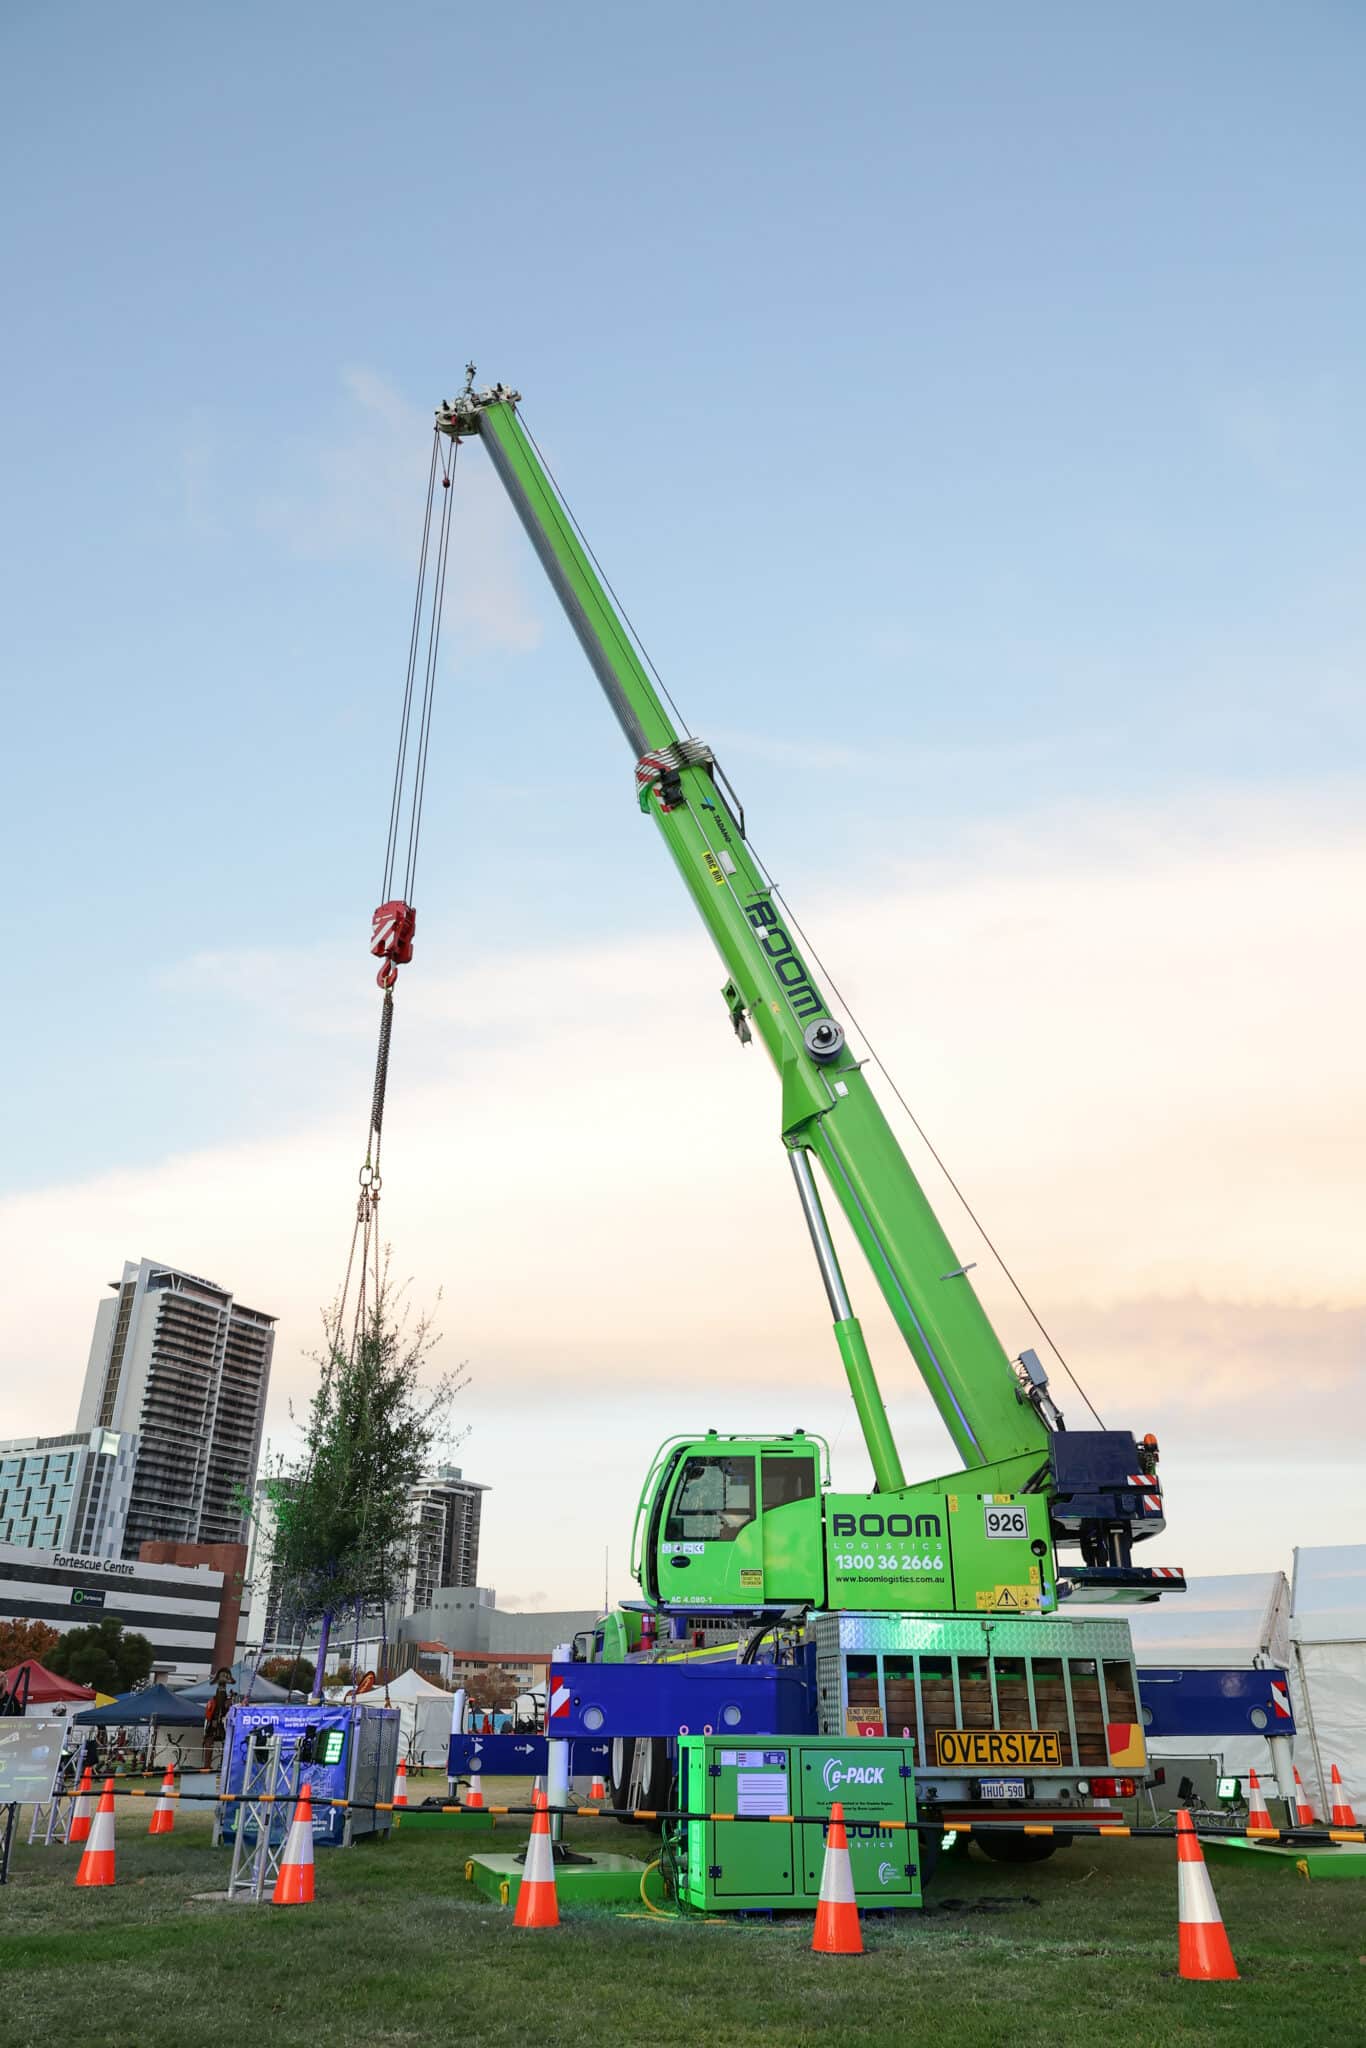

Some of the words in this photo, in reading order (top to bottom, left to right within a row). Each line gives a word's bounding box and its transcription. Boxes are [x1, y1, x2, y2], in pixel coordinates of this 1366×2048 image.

[713, 815, 732, 842] TADANO
[745, 901, 822, 1018] BOOM
[833, 1514, 942, 1537] BOOM
[988, 1514, 1024, 1531] 926
[833, 1542, 942, 1550] LOGISTICS
[53, 1554, 102, 1571] Fortescue
[103, 1560, 135, 1575] Centre
[835, 1555, 875, 1570] 1300
[877, 1555, 898, 1570] 36
[901, 1555, 943, 1570] 2666
[836, 1575, 945, 1584] www.boomlogistics.com.au
[243, 1715, 279, 1725] BOOM
[941, 1735, 1057, 1763] OVERSIZE
[832, 1767, 884, 1784] e-PACK
[822, 1841, 894, 1849] LISTICS
